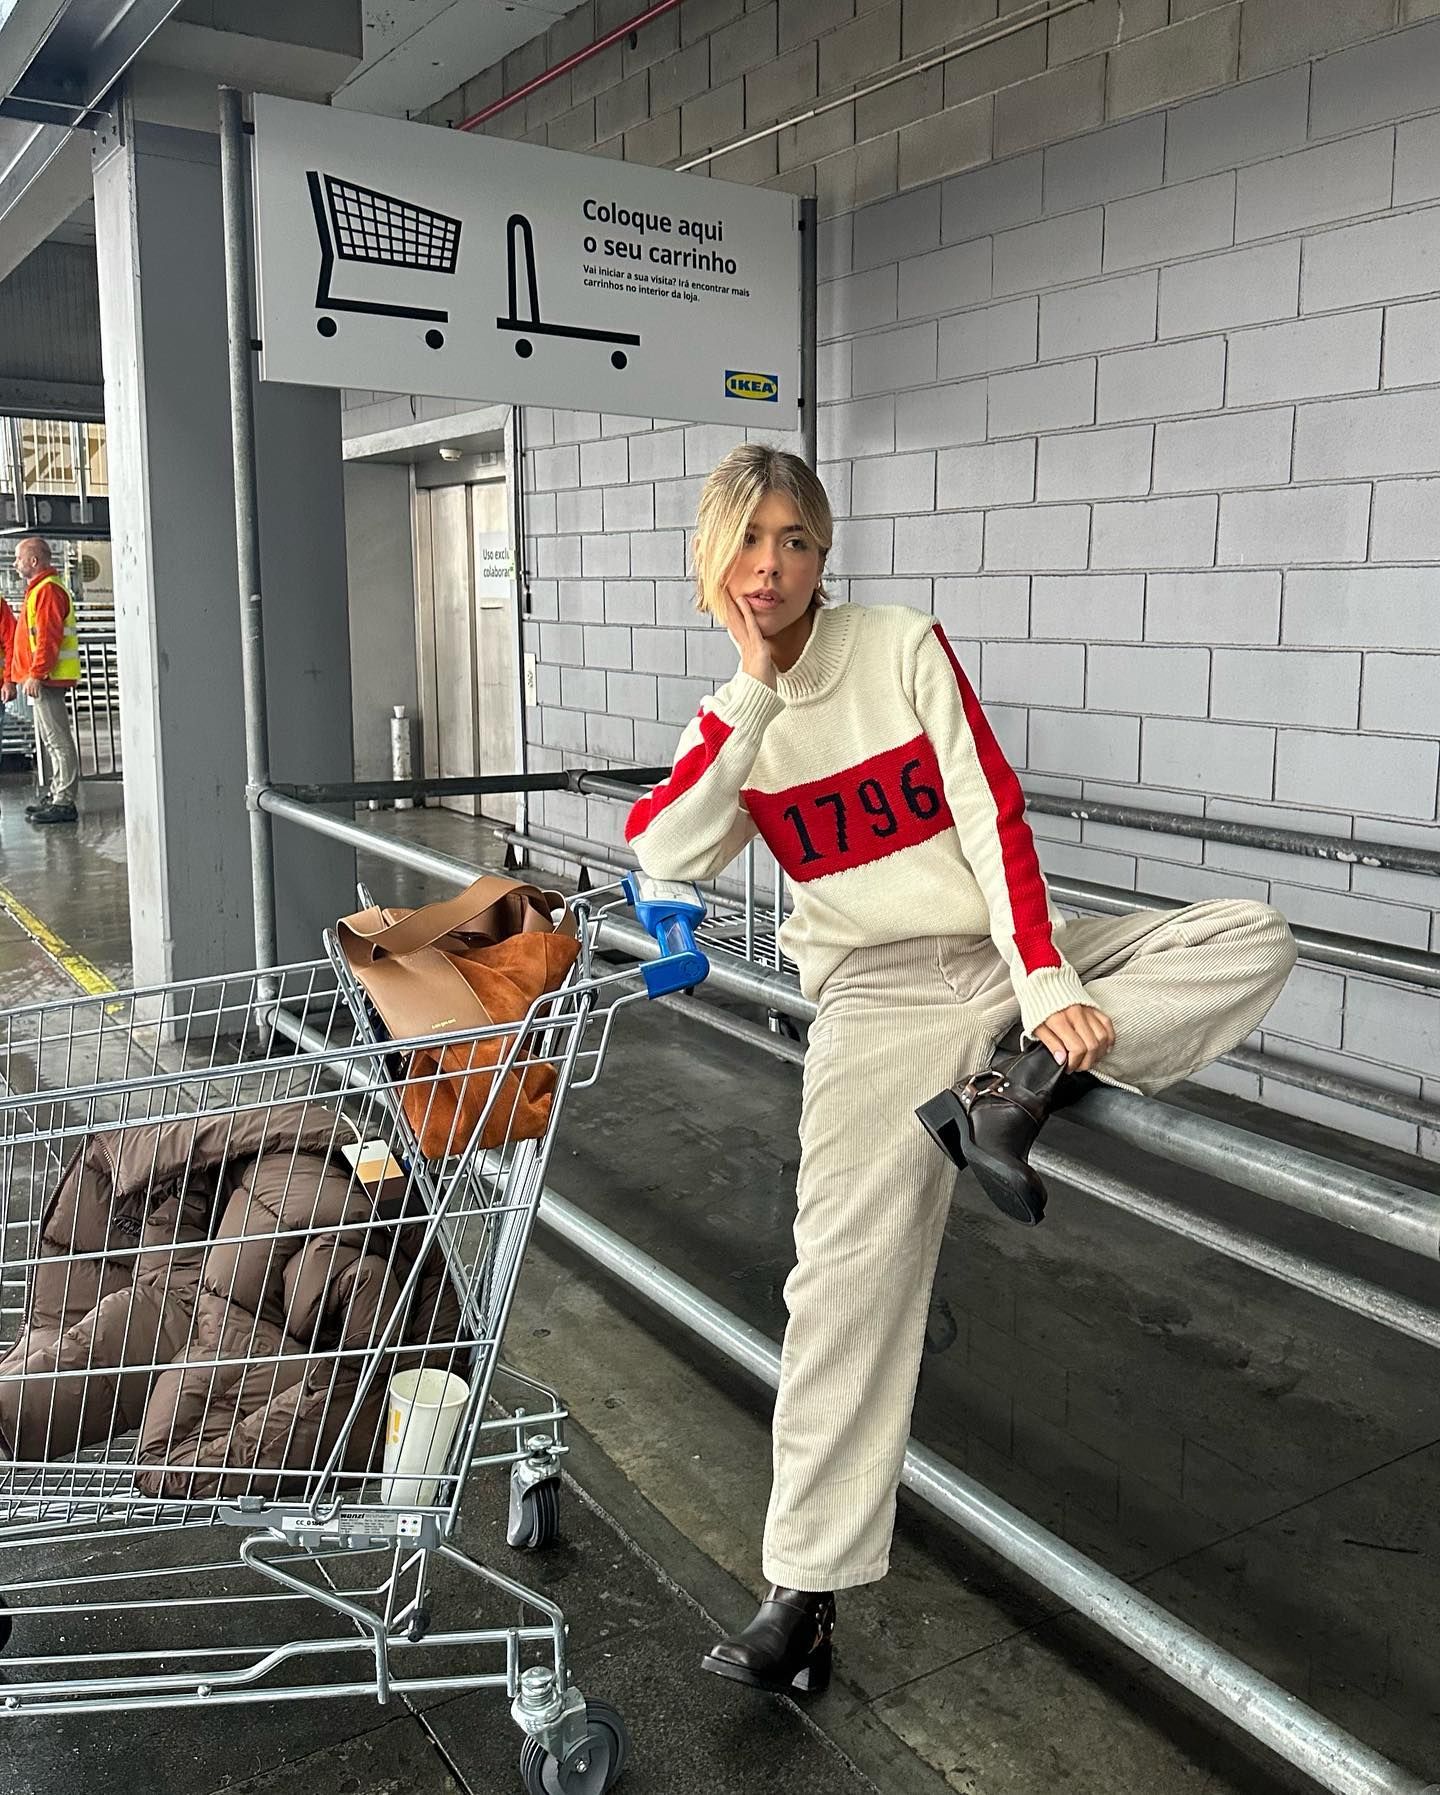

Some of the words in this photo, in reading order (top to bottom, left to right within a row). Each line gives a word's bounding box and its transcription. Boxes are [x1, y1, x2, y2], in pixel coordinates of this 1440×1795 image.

[583, 199, 672, 235] Coloque
[678, 219, 723, 245] aqui
[583, 236, 597, 253] o
[604, 239, 641, 261] seu
[649, 247, 737, 275] carrinho
[583, 264, 597, 275] Vai
[599, 265, 625, 279] iniciar
[626, 272, 632, 280] a
[634, 273, 649, 282] sua
[650, 274, 677, 287] visita?
[678, 278, 690, 288] Irá
[691, 281, 730, 294] encontrar
[731, 287, 750, 297] mais
[583, 278, 624, 291] carrinhos
[626, 284, 637, 293] no
[639, 284, 670, 297] interior
[671, 289, 682, 299] da
[683, 290, 700, 303] loja.
[730, 378, 774, 394] IKEA
[483, 548, 494, 560] Uso
[783, 758, 940, 865] 1796
